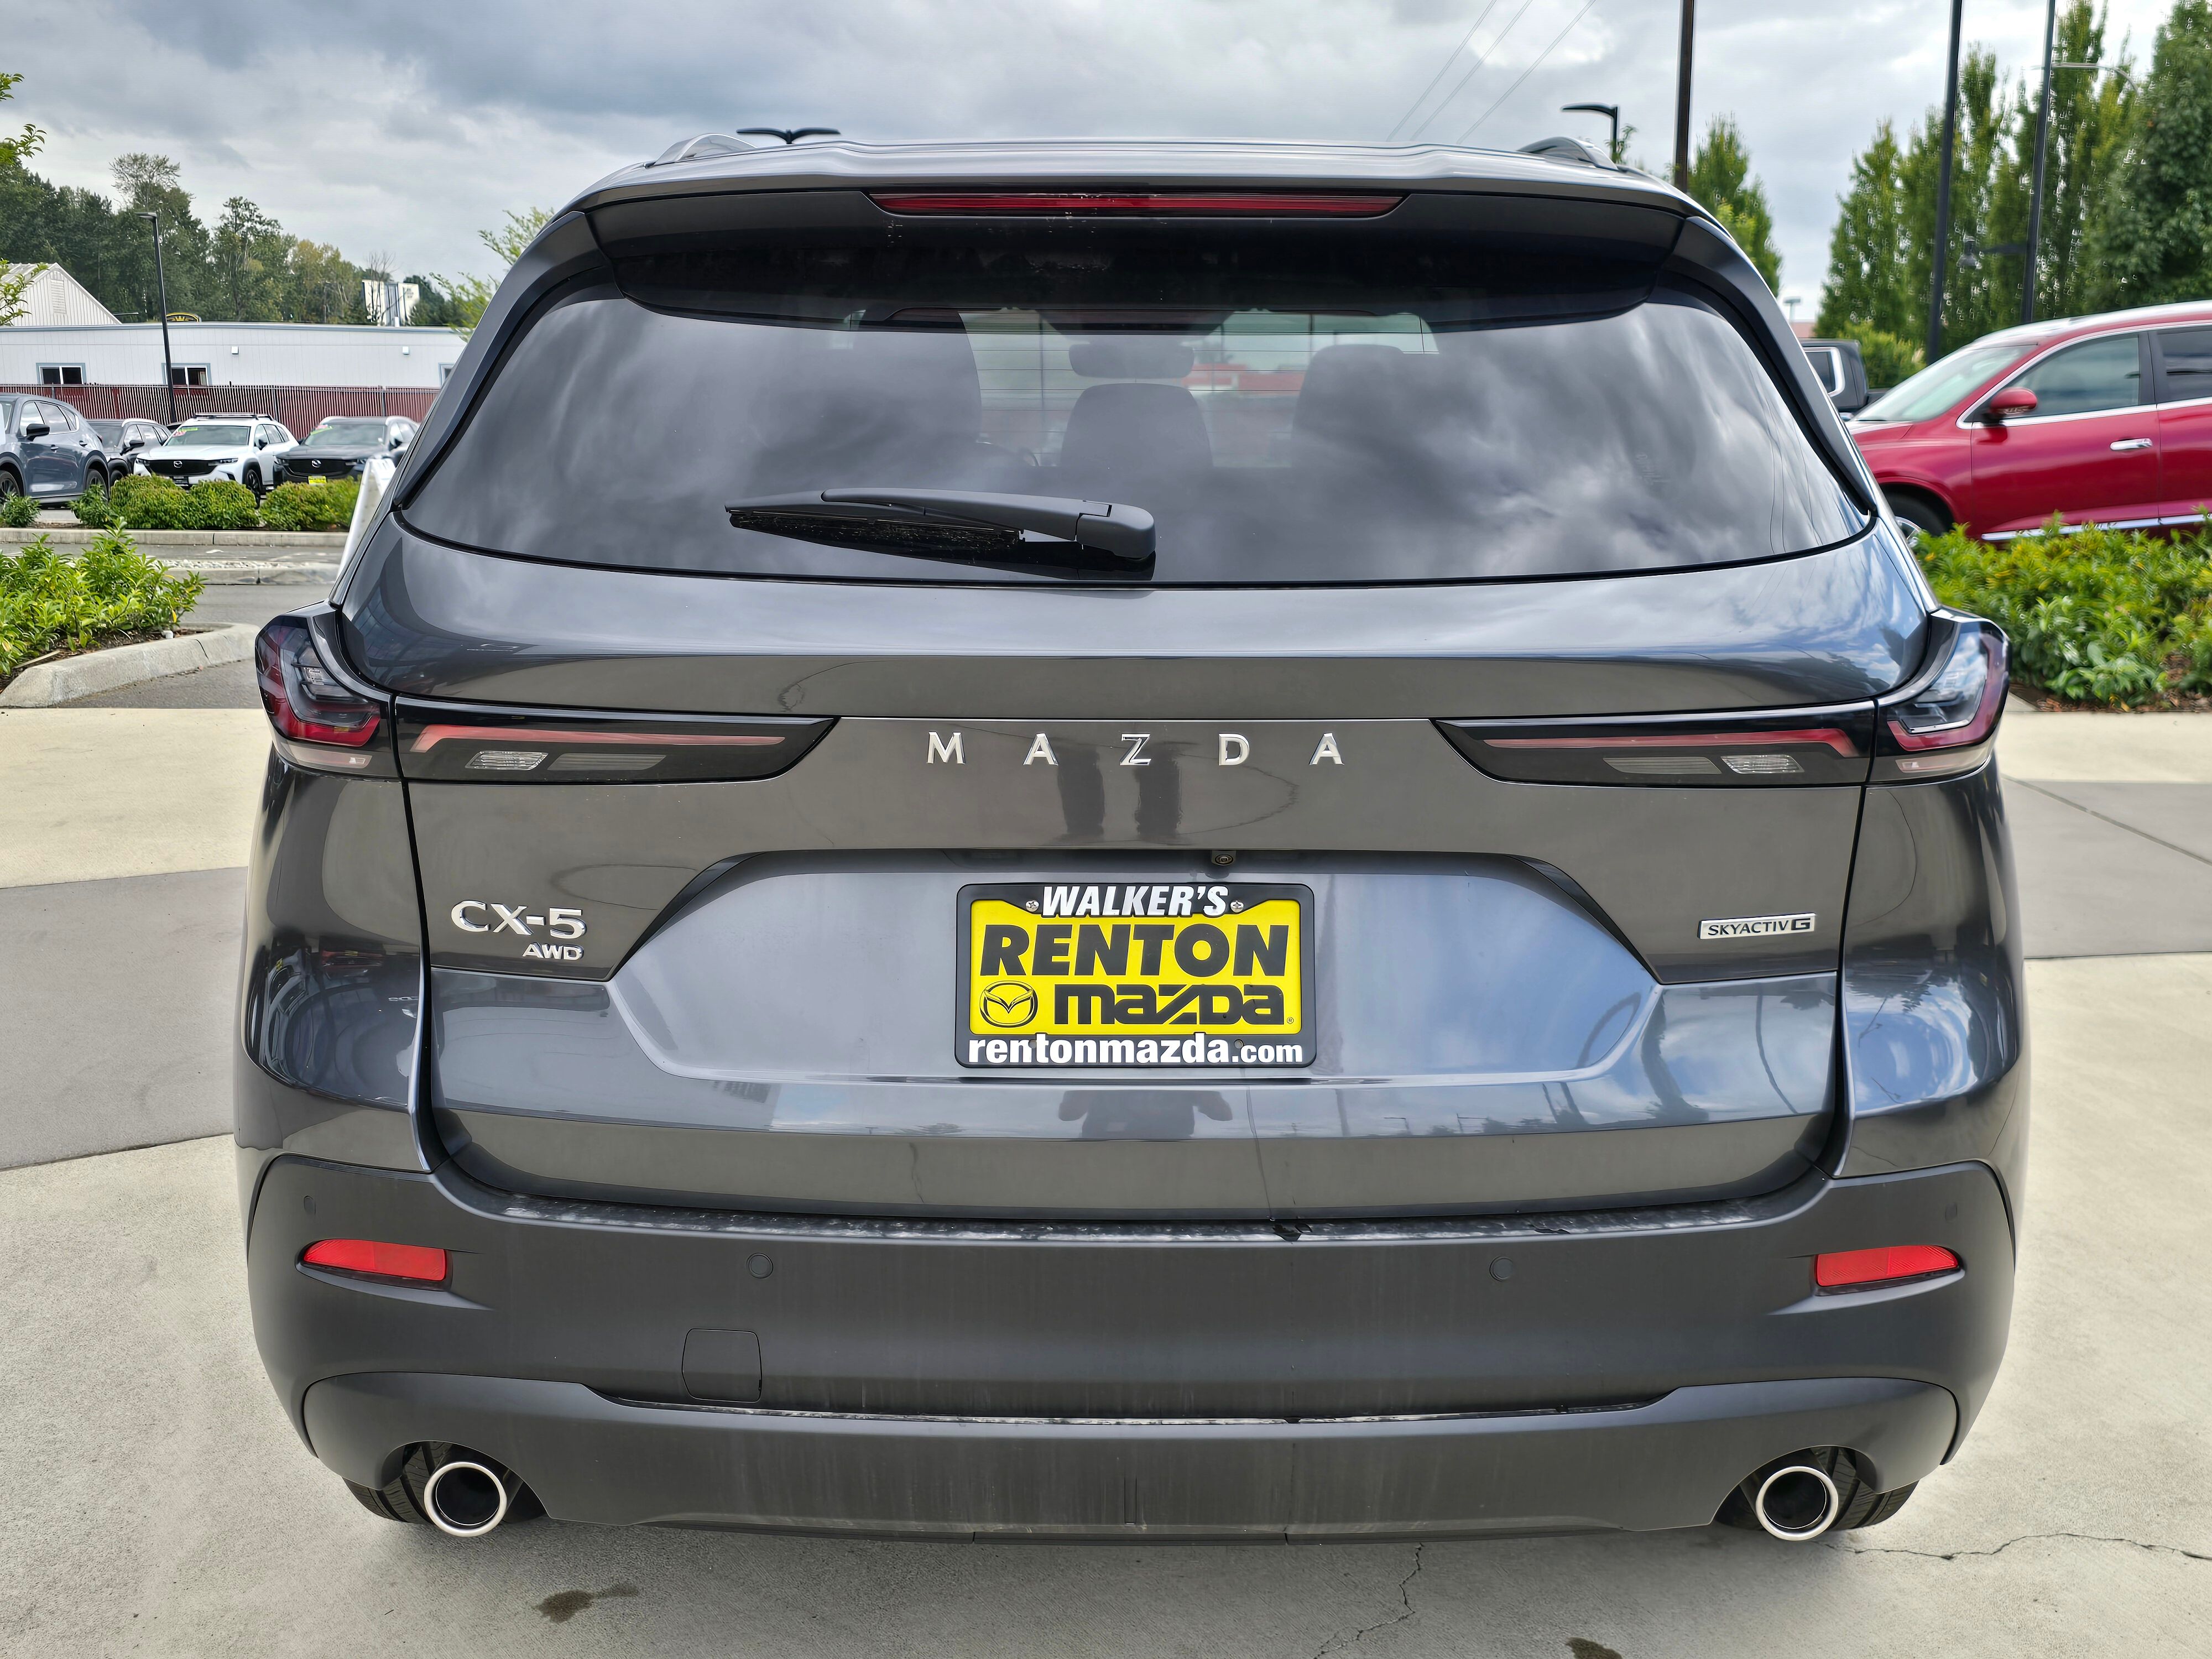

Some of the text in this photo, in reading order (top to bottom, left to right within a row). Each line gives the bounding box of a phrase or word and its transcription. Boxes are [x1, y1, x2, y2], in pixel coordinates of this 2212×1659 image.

[927, 731, 1345, 766] MAZDA
[1042, 885, 1229, 916] WALKER'S
[451, 900, 587, 939] CX-5
[522, 942, 584, 961] AWD
[980, 923, 1289, 977] RENTON
[968, 1032, 1303, 1063] rentonmazda.com
